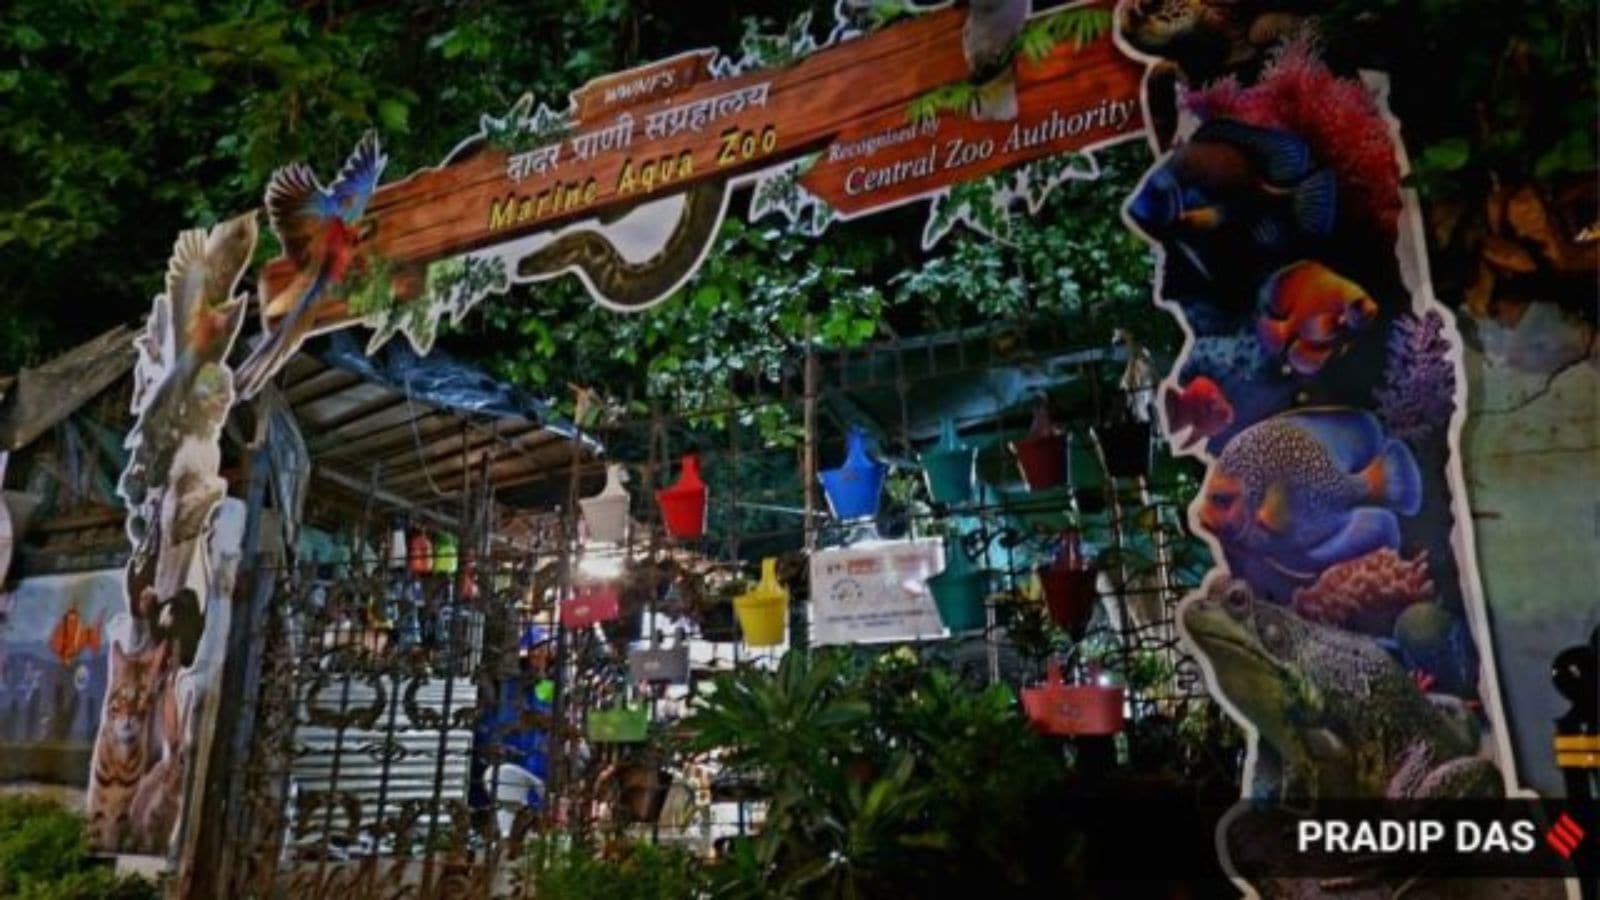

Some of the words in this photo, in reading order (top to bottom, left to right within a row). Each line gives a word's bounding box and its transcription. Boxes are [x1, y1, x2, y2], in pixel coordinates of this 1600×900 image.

[488, 176, 599, 230] Marine
[618, 150, 694, 194] Aqua
[717, 122, 778, 166] Zoo
[506, 143, 561, 183] दादर
[571, 112, 634, 163] प्राणी
[645, 82, 771, 141] संग्रहालय
[844, 145, 937, 196] Central
[942, 138, 994, 170] Zoo
[1002, 98, 1135, 152] Authority
